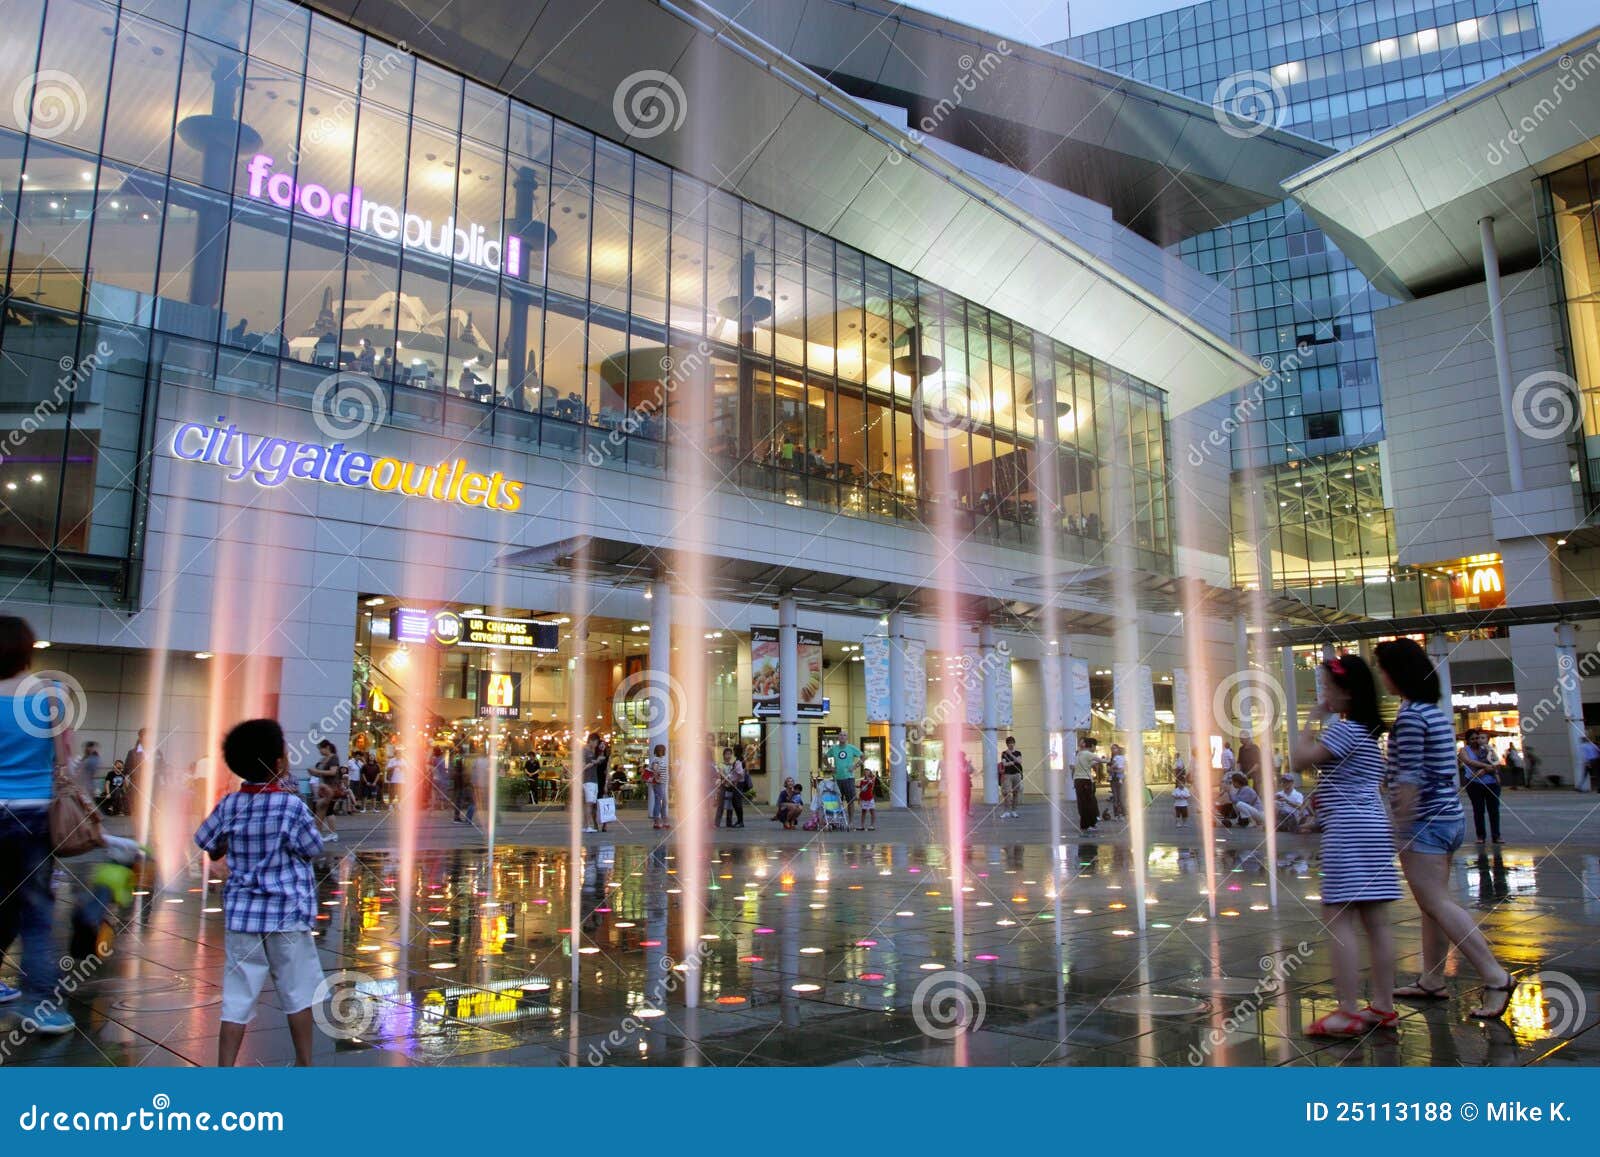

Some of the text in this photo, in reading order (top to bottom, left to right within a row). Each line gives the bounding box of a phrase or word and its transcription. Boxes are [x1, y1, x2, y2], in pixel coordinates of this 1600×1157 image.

[248, 154, 504, 272] foodrepublic
[171, 415, 525, 513] citygateoutlets
[470, 620, 527, 634] UA CINEMAS
